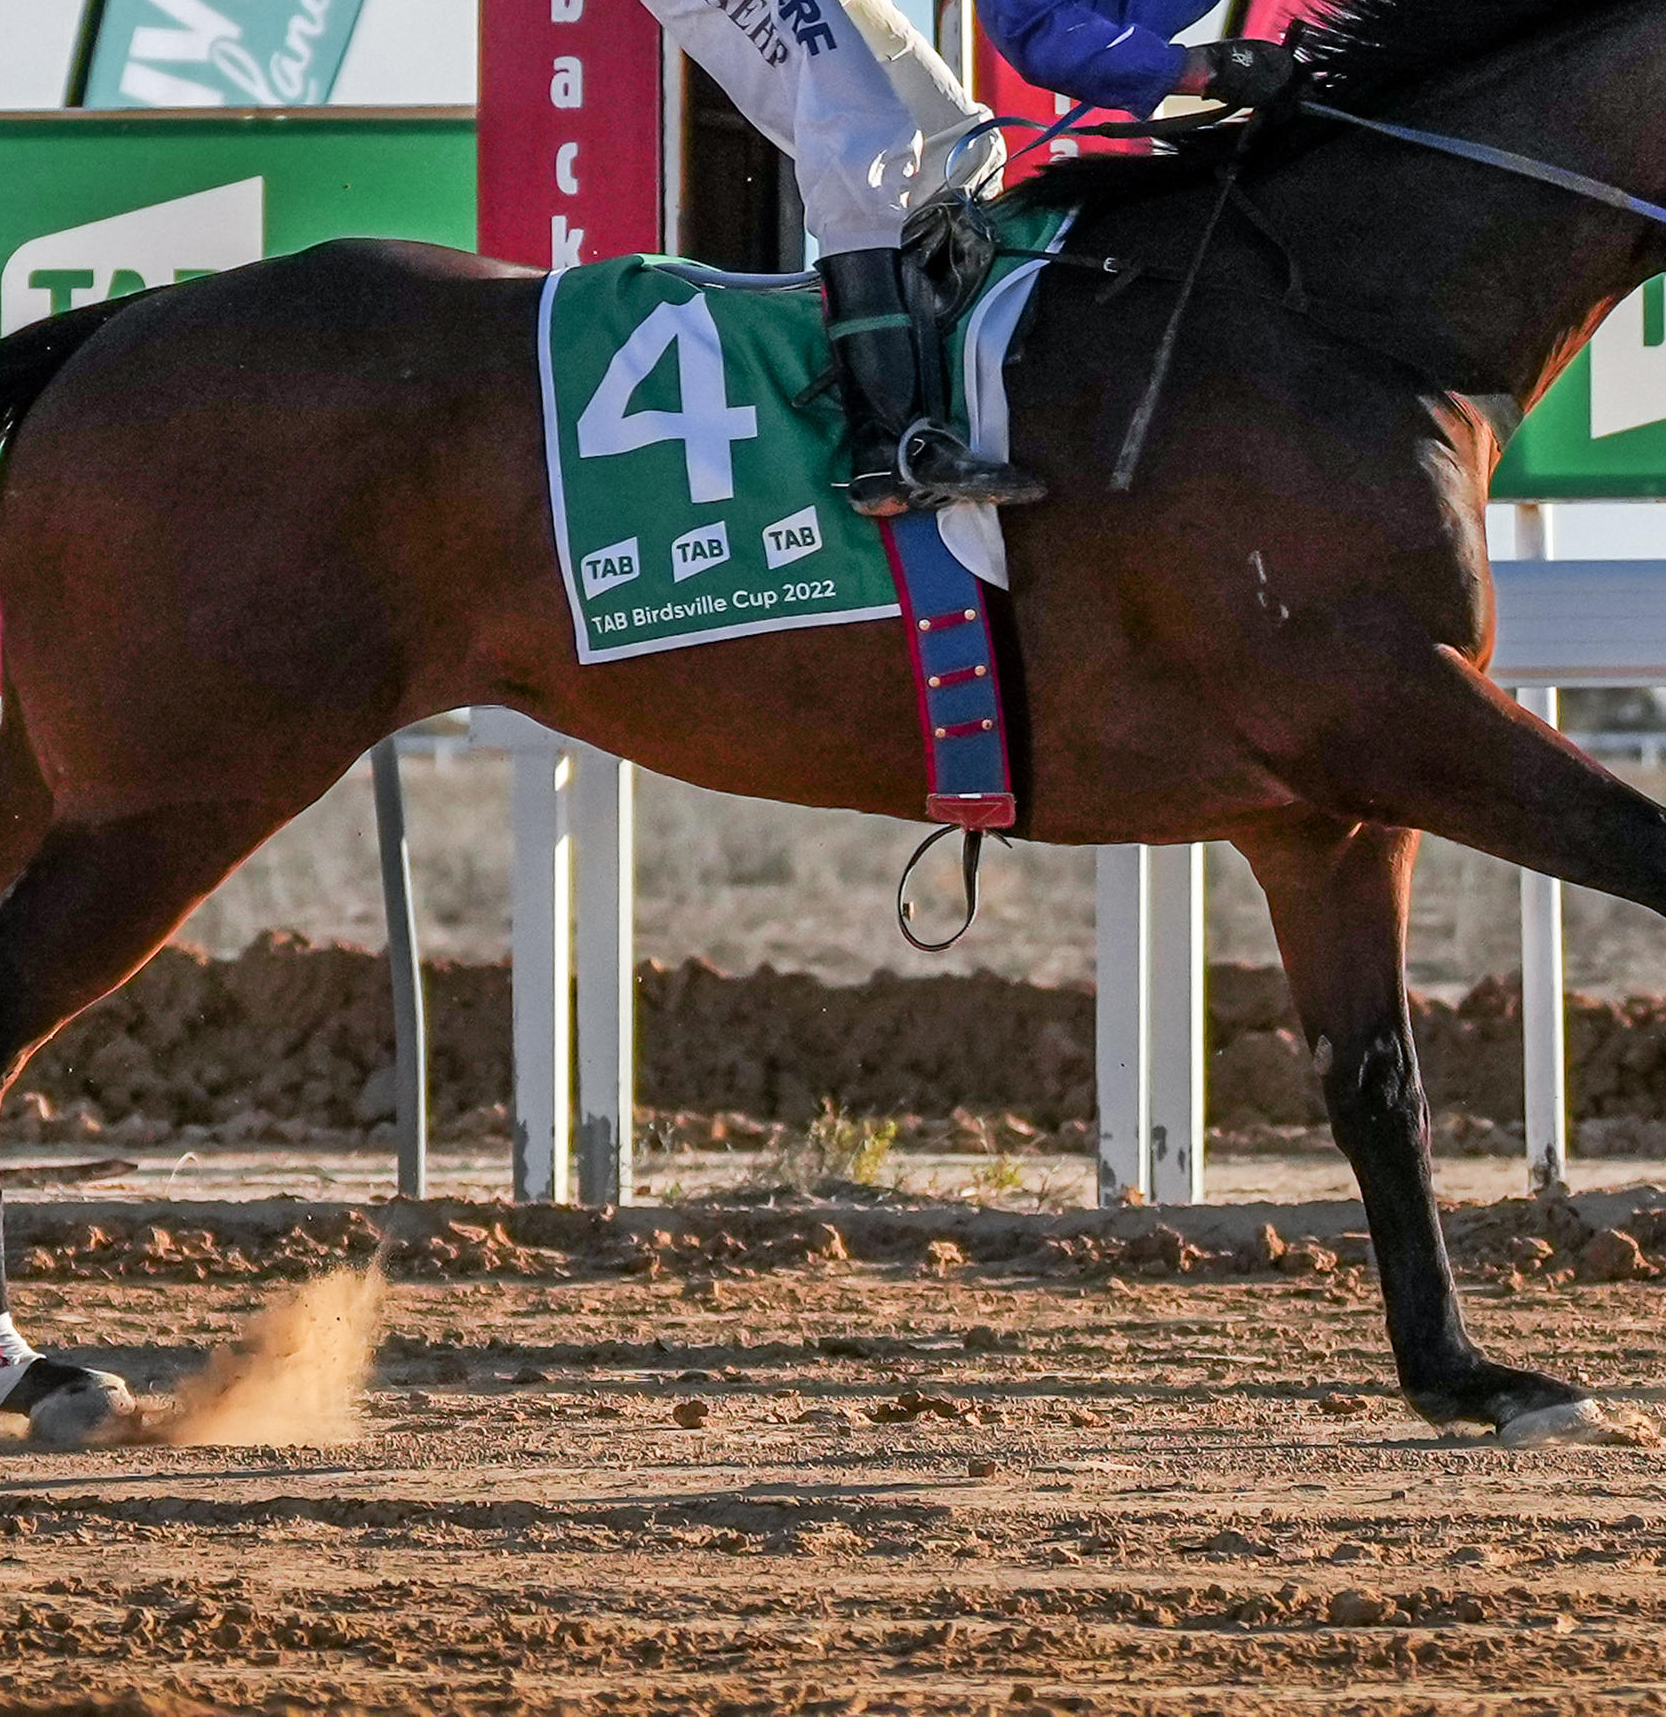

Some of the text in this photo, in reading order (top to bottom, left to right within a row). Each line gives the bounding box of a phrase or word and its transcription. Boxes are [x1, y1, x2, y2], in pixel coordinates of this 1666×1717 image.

[576, 292, 757, 504] 4
[676, 538, 725, 563] TAB
[768, 526, 816, 551] TAB
[585, 556, 634, 580] TAB
[591, 579, 837, 634] TAB Birdsville Cup 2022
